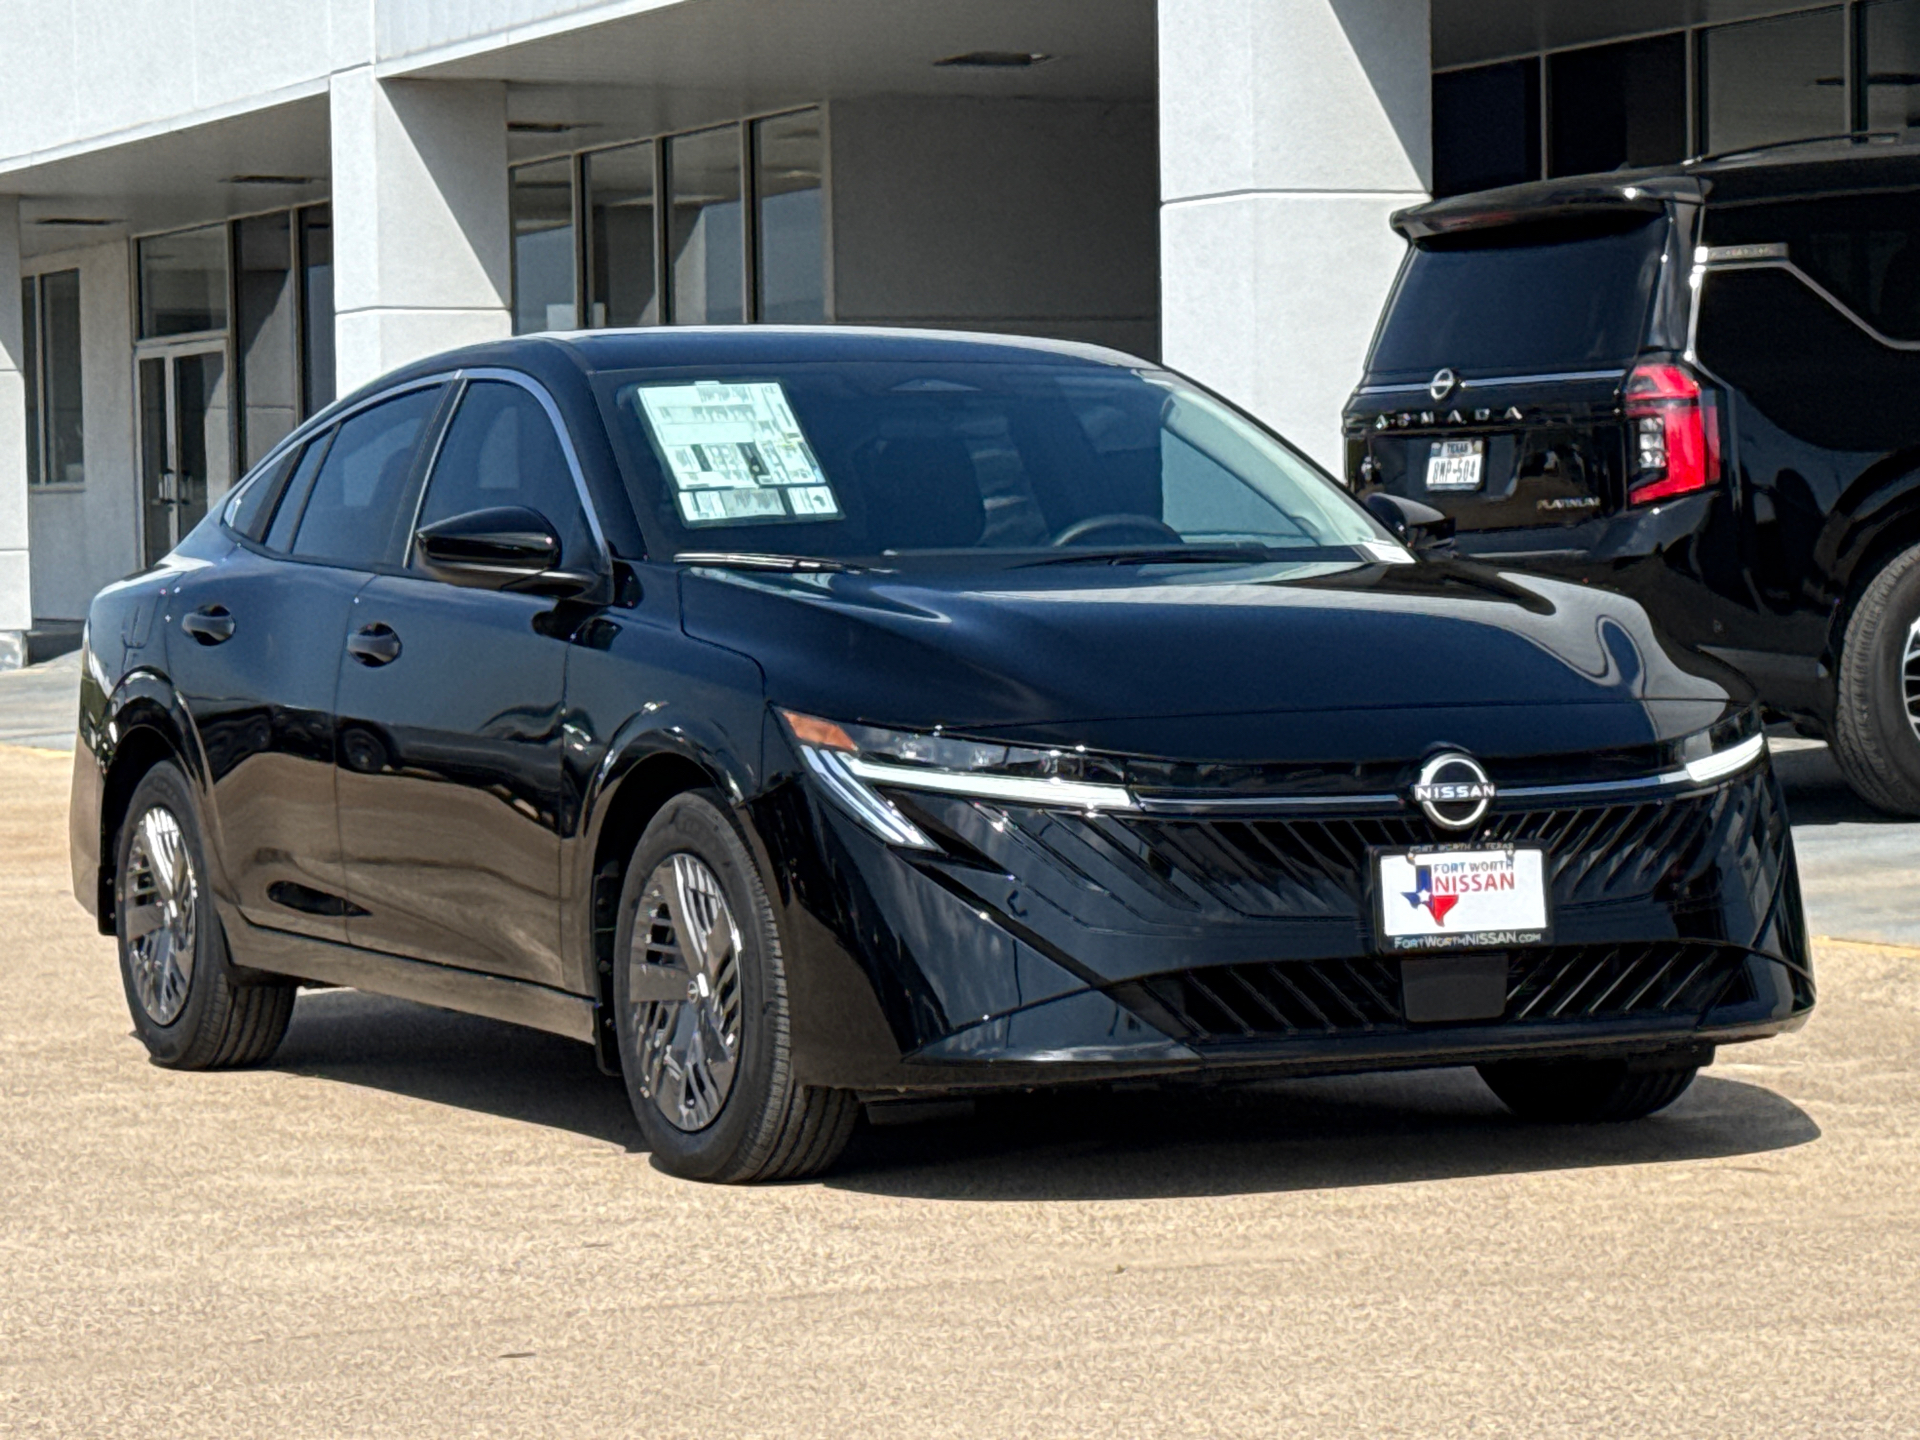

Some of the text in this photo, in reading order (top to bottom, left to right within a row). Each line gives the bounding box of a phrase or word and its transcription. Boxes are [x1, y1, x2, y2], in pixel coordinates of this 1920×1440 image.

[1376, 406, 1523, 430] ARMADA
[1417, 784, 1495, 800] NISSAN
[1485, 842, 1514, 851] TEXAS
[1434, 859, 1515, 874] FORT WORTH
[1435, 872, 1515, 893] NISSAN
